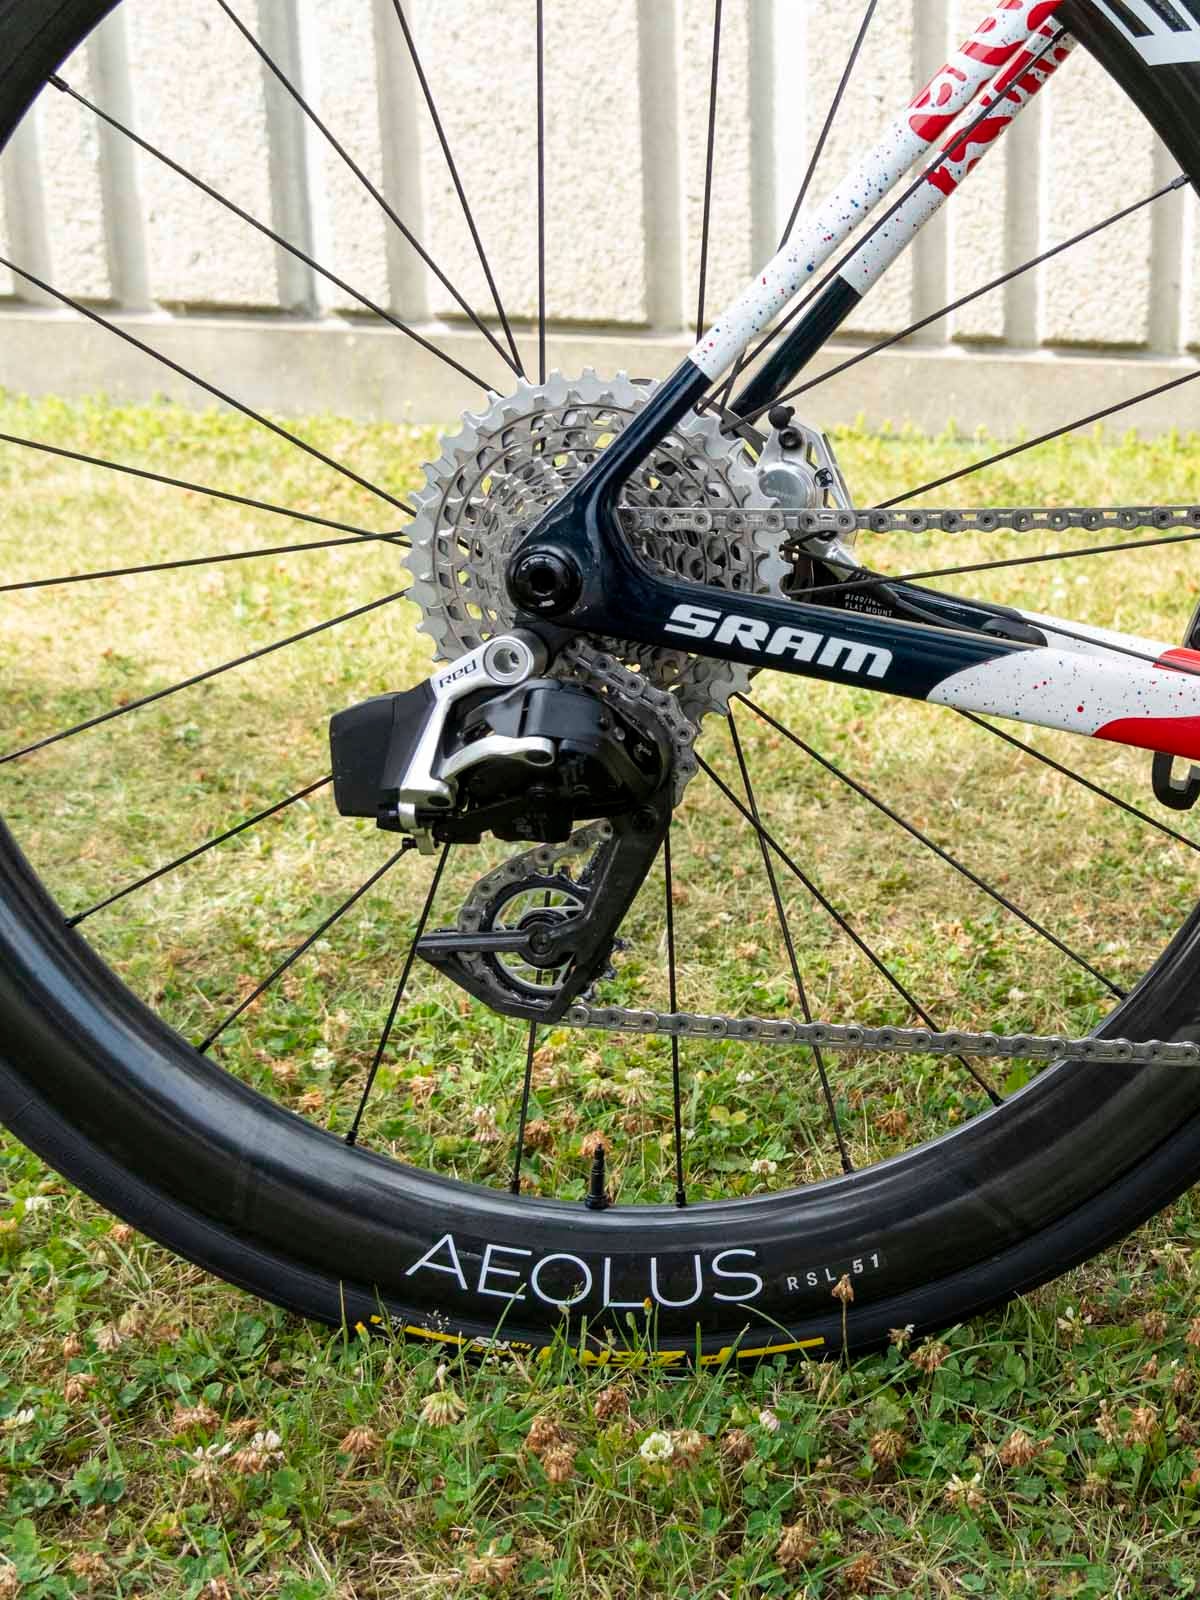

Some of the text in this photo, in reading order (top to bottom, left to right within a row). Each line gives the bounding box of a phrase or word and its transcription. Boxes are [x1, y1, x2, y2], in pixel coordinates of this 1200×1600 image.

[664, 604, 894, 679] SRAM
[865, 605, 893, 617] MOUNT
[405, 1233, 881, 1308] AEOLUS RSL 51
